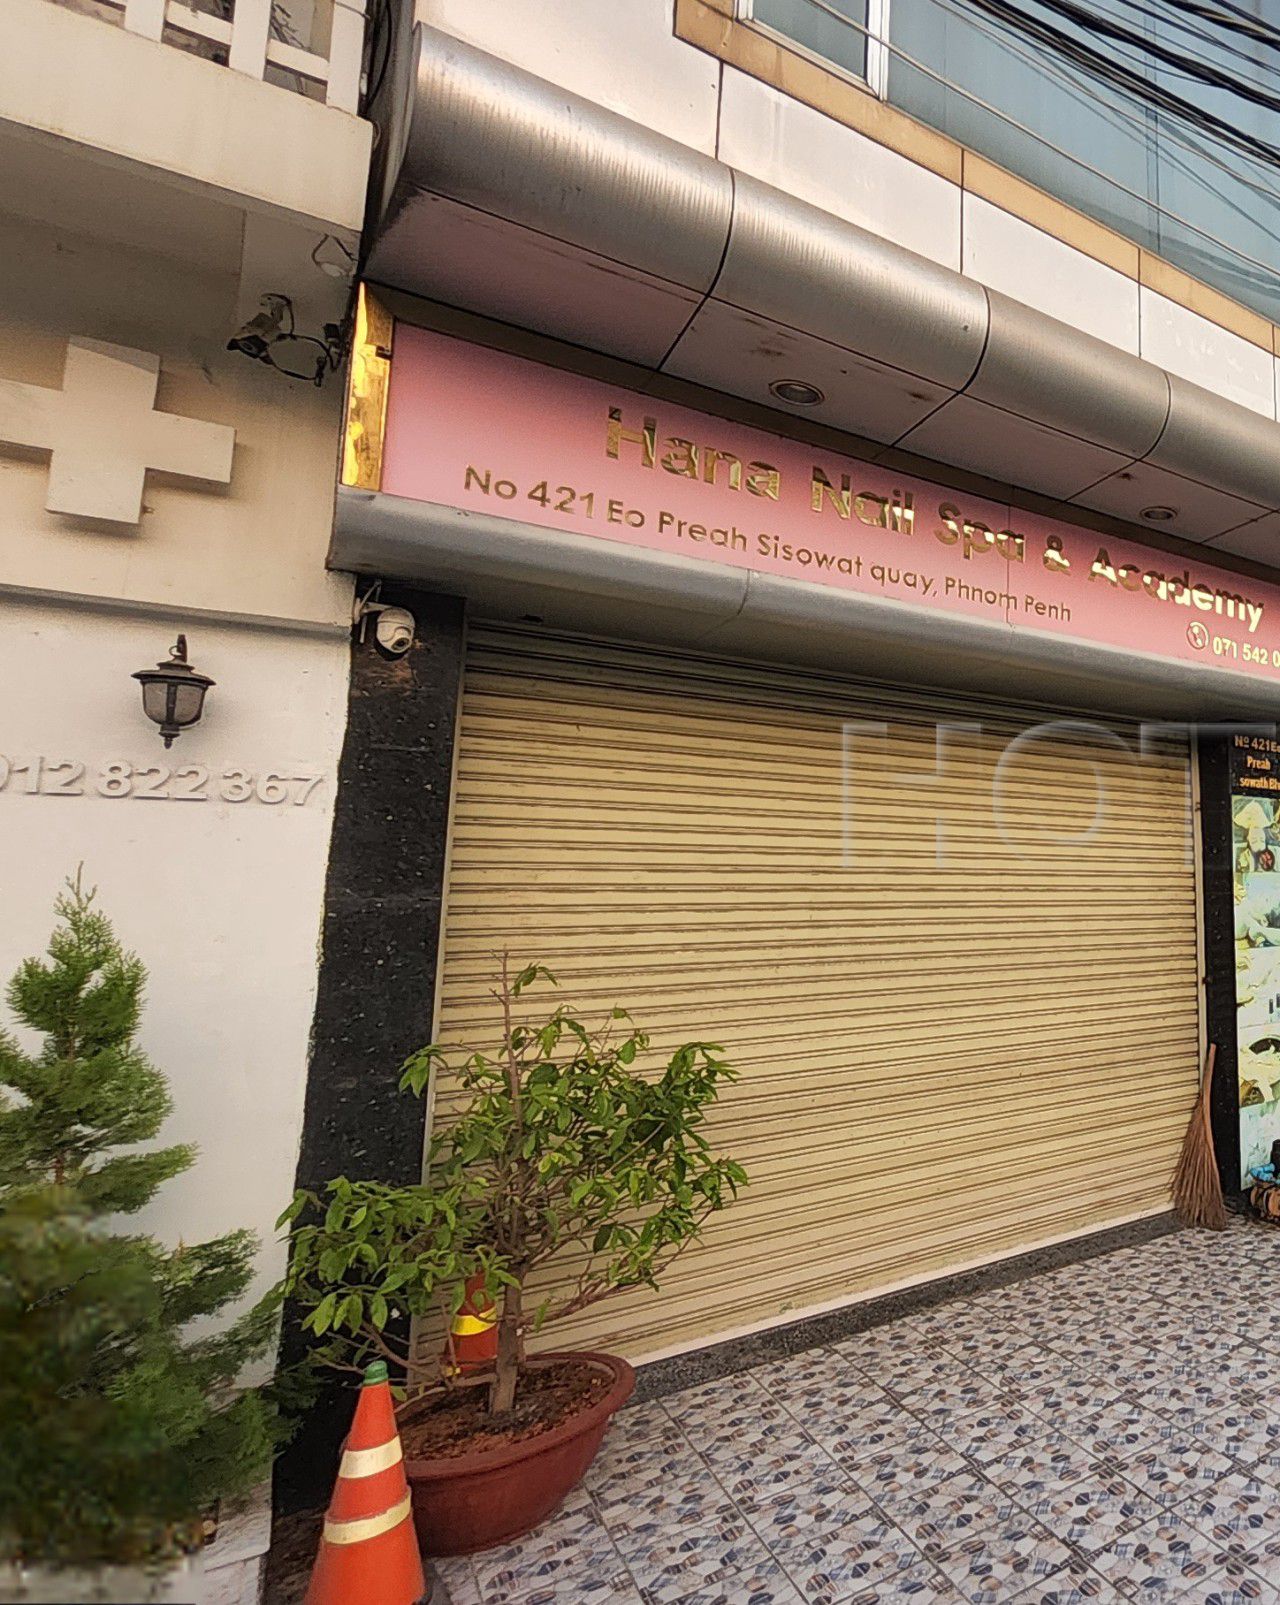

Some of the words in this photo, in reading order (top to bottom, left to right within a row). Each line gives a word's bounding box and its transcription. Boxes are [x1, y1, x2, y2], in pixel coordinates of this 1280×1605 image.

[464, 465, 517, 500] No
[527, 480, 595, 519] 421
[607, 500, 645, 528] Eo
[658, 511, 747, 552] Preah
[757, 533, 863, 577] Sisowat
[870, 560, 939, 597] quay,
[945, 576, 1018, 610] Phnom
[1025, 594, 1071, 622] Penh
[606, 406, 781, 501] Hana
[811, 466, 915, 536] Nail
[934, 502, 1025, 562] Spa
[1043, 535, 1072, 576] &
[1088, 547, 1265, 632] Academy
[1212, 636, 1238, 660] 071
[1243, 639, 1269, 664] 542
[98, 759, 209, 801] 822
[220, 767, 325, 806] 367
